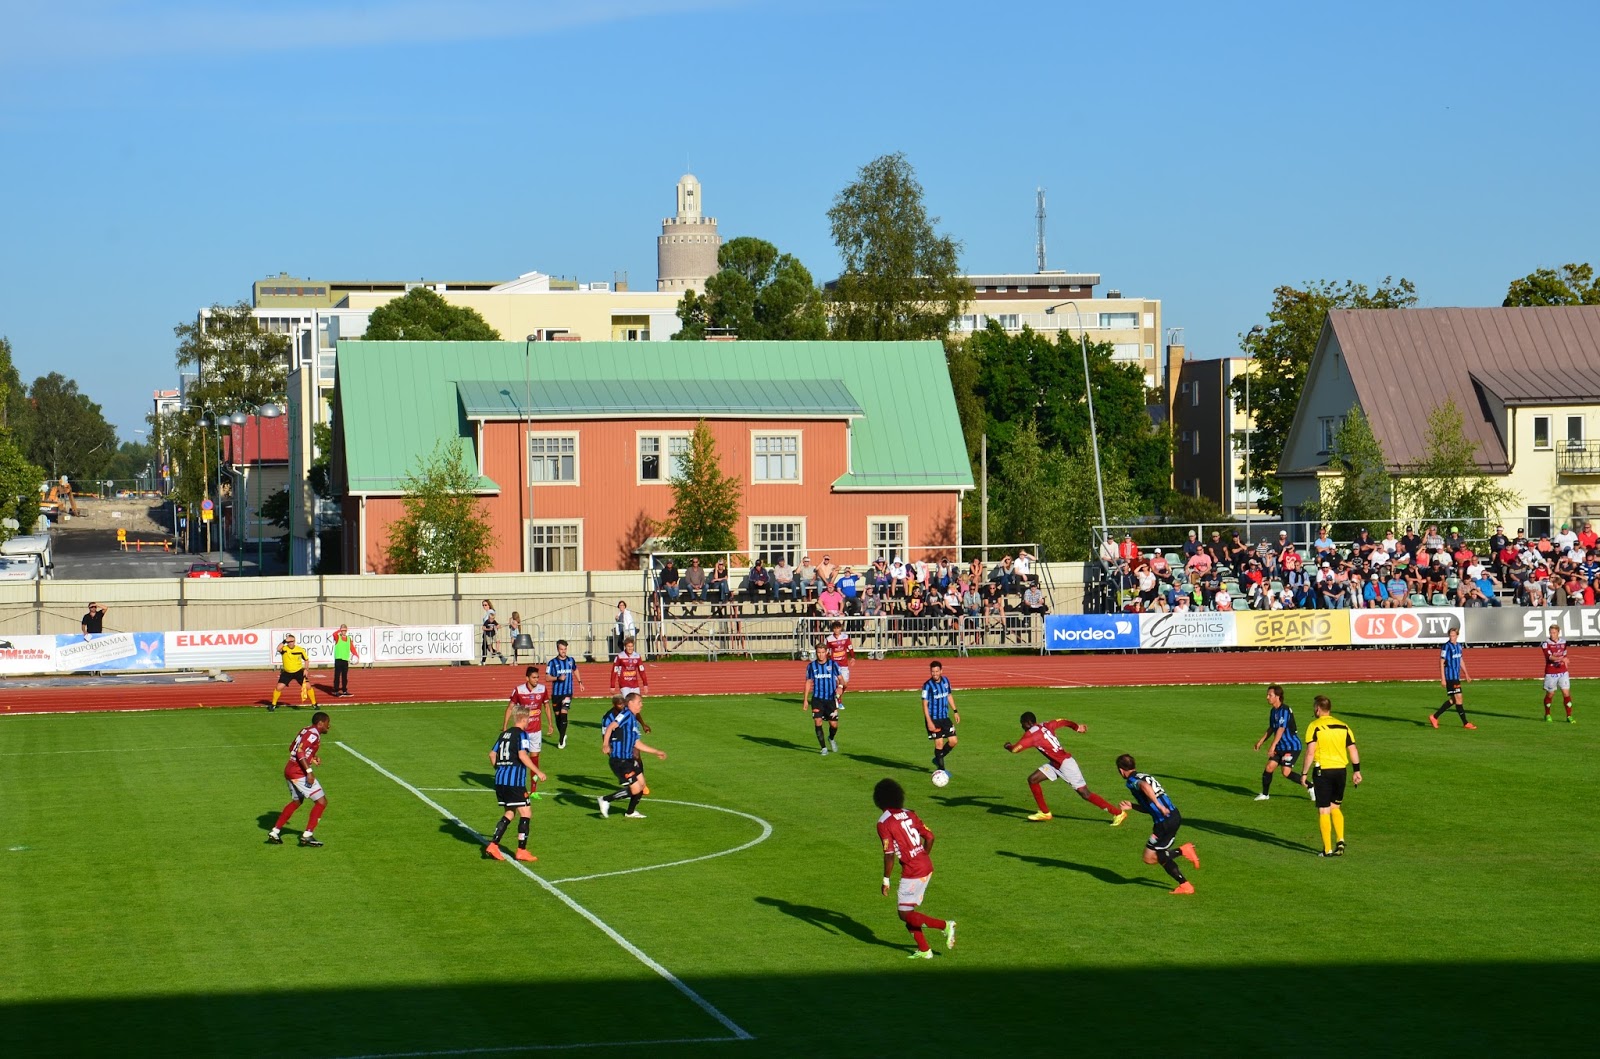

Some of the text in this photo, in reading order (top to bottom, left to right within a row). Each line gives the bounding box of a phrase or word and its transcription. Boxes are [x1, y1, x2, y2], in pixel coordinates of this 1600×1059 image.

[1150, 613, 1224, 647] Graphics
[1255, 619, 1331, 636] GRANO
[1367, 618, 1385, 635] IS
[1426, 617, 1452, 634] TV
[1523, 608, 1600, 637] SELE
[176, 633, 259, 647] ELKAMO
[297, 632, 322, 645] Jaro
[382, 630, 463, 642] FF Jaro tackar
[1053, 627, 1116, 641] Nordea
[381, 642, 463, 655] Anders Wiklöf
[499, 740, 511, 761] 14
[900, 818, 921, 847] 15
